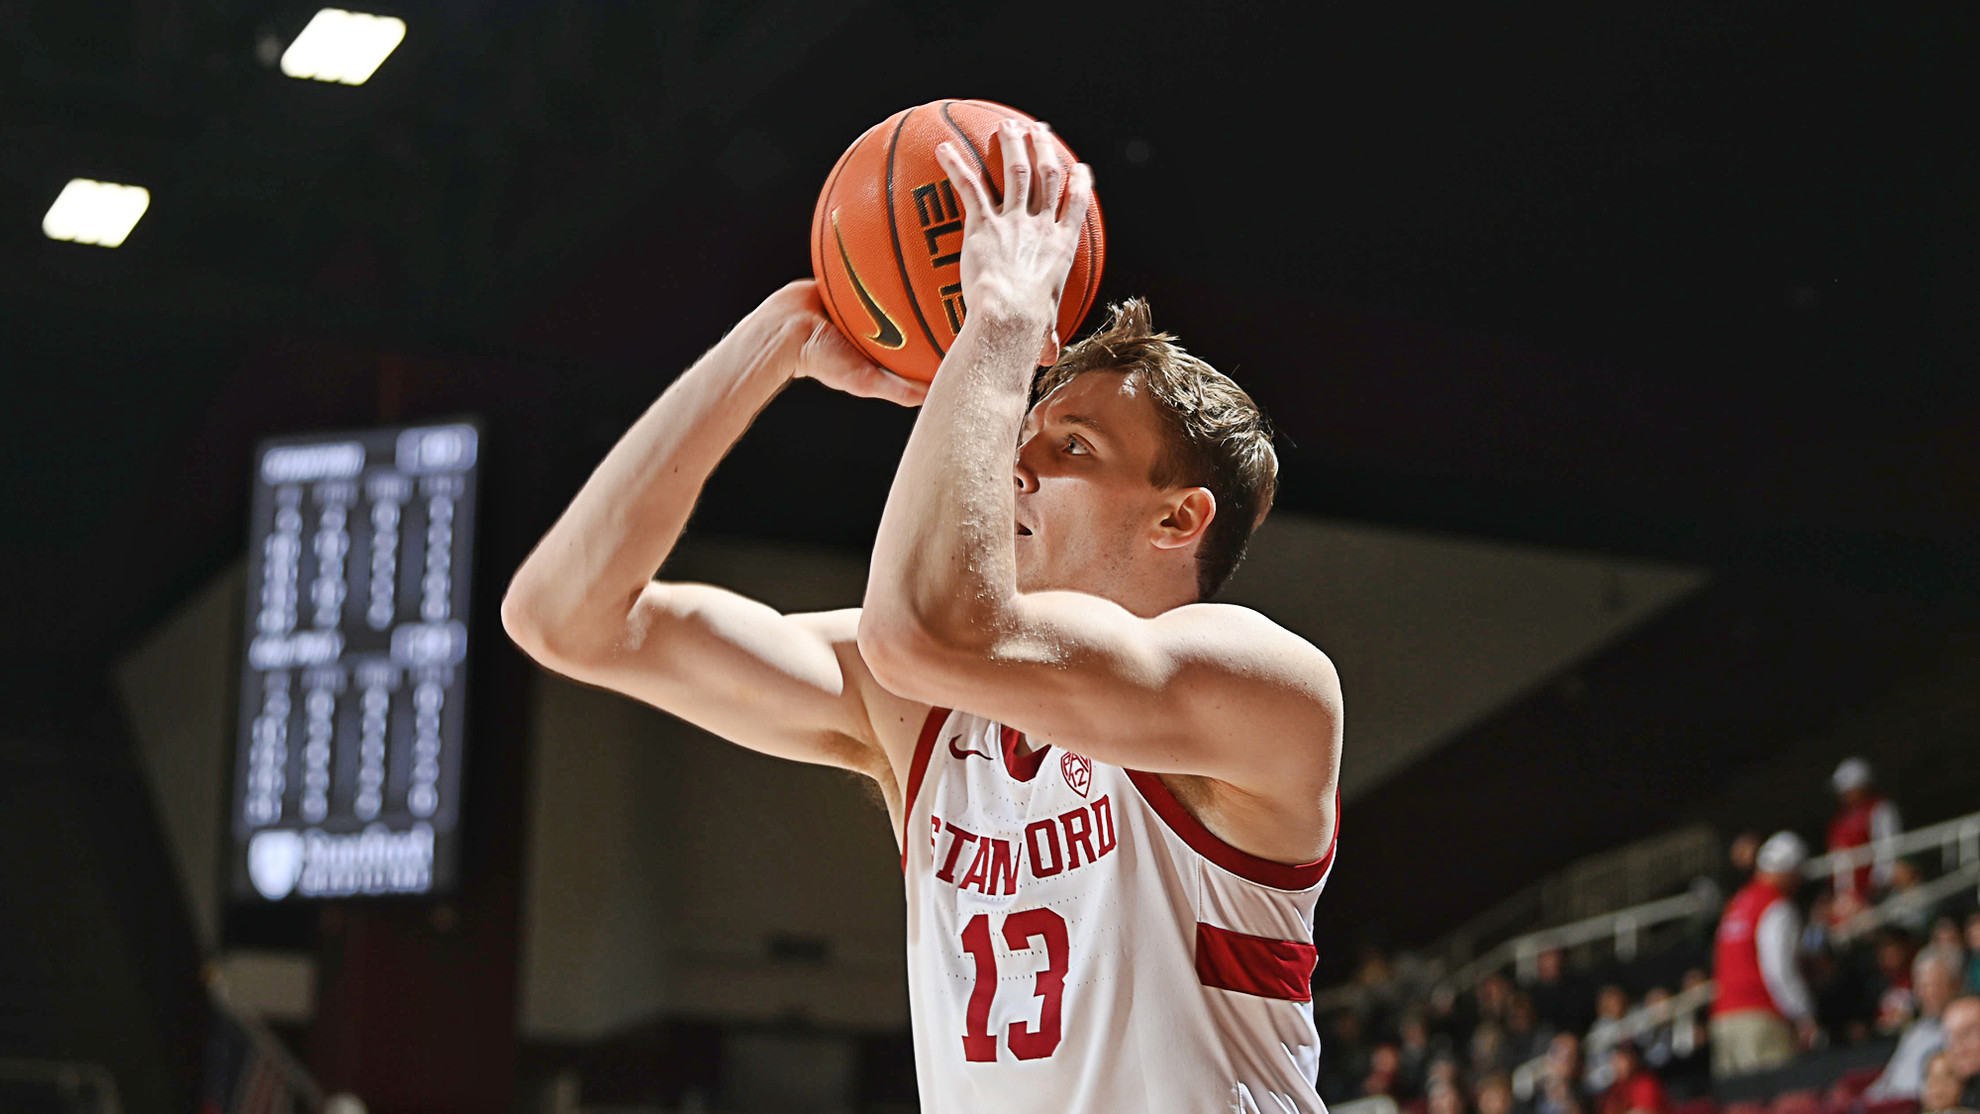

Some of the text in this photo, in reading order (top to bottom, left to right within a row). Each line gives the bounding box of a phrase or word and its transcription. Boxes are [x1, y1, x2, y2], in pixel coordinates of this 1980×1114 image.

[1070, 767, 1087, 788] 12
[931, 794, 1117, 896] TANORD
[961, 907, 1070, 1063] 13
